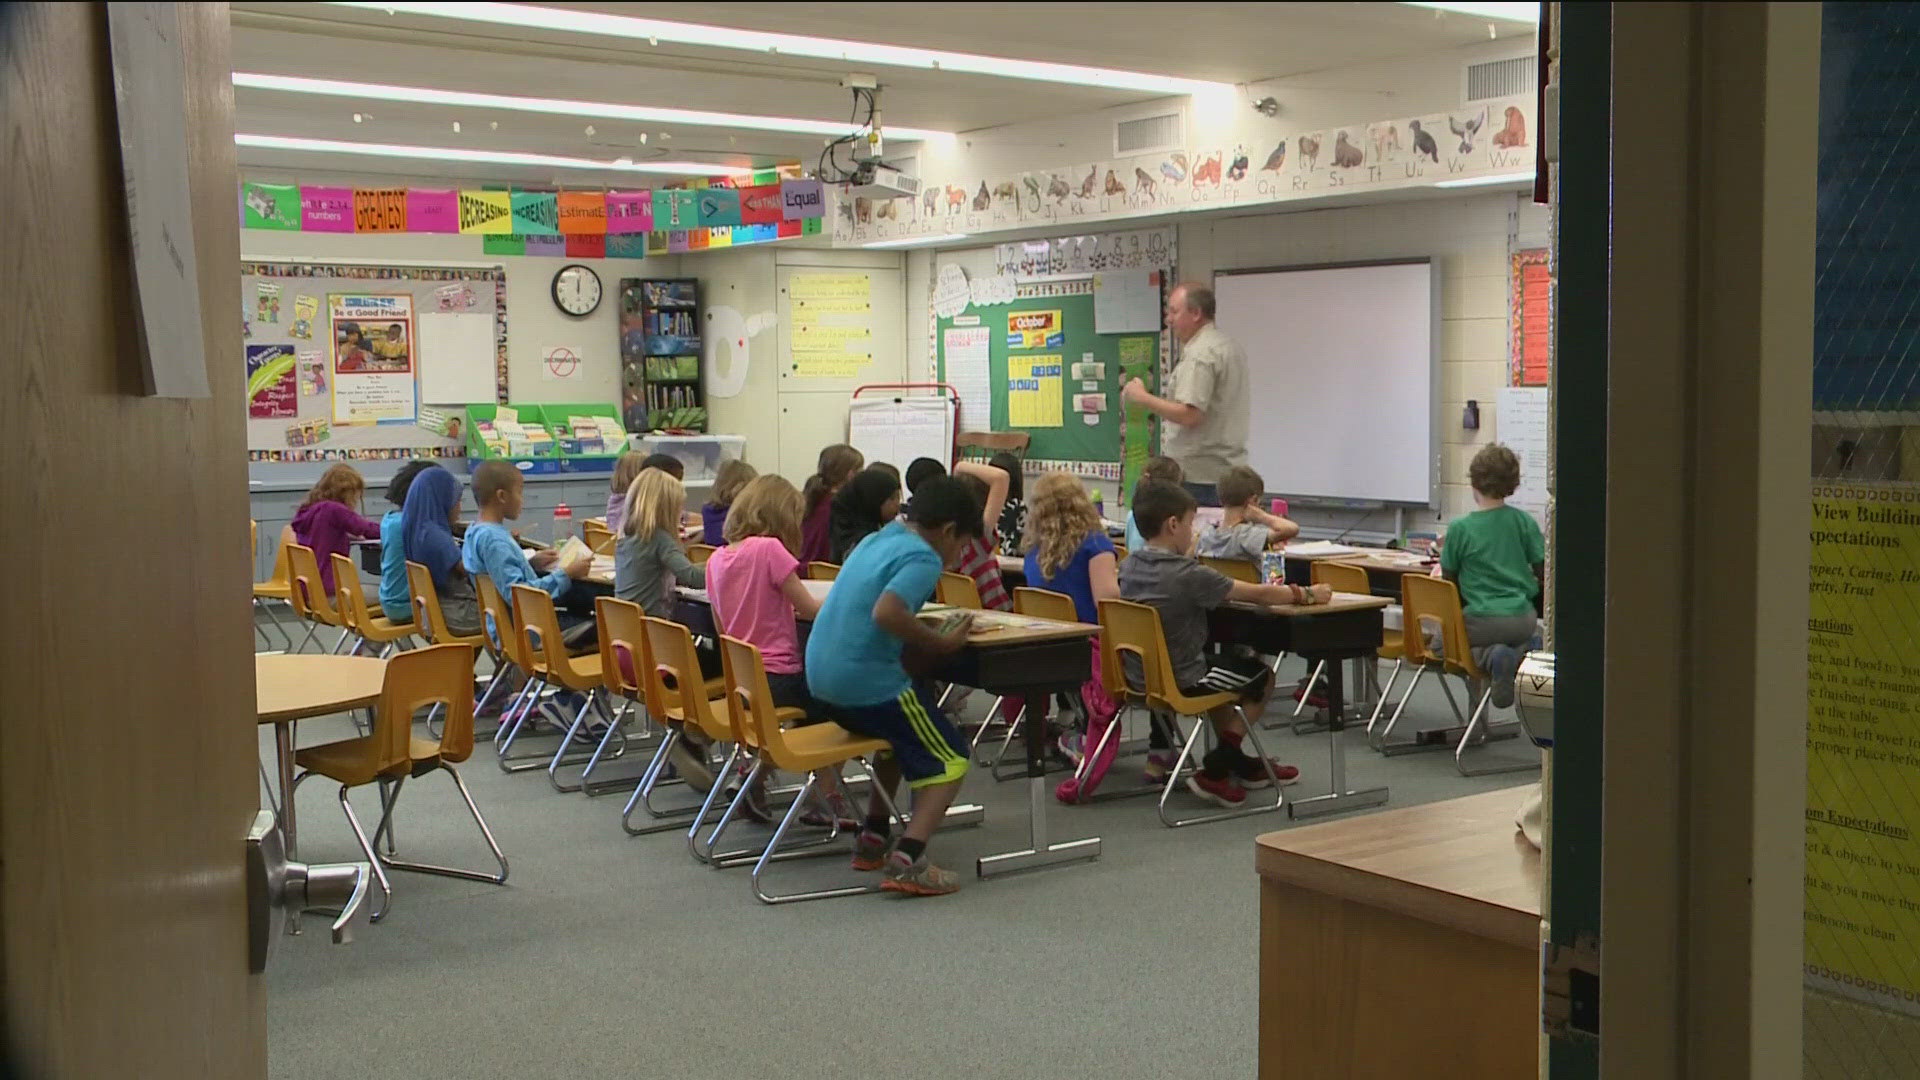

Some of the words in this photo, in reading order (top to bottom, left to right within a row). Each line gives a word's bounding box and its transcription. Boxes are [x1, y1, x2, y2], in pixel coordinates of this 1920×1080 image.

[786, 190, 820, 209] Equal
[856, 227, 867, 239] Bb
[1071, 202, 1084, 215] Kk
[1129, 196, 1148, 209] Mm
[1160, 192, 1175, 205] Nn
[1191, 188, 1208, 202] Oo
[1224, 185, 1239, 202] Pp
[1257, 180, 1277, 199] Qq
[1292, 176, 1308, 191] Rr
[1329, 171, 1344, 187] Ss
[1368, 165, 1381, 182] Tt
[1405, 163, 1423, 178] Uu
[1448, 157, 1464, 173] Vv
[1489, 151, 1520, 168] Ww
[308, 211, 341, 221] numbers
[355, 191, 405, 229] GREATEST
[460, 195, 509, 229] DECREASING
[335, 309, 344, 317] Be
[356, 309, 379, 317] Good
[1016, 316, 1046, 327] October
[1813, 503, 1850, 520] View
[1849, 565, 1894, 584] Caring,
[1843, 582, 1875, 596] Trust
[1830, 656, 1850, 667] and
[1854, 657, 1881, 670] food
[1827, 673, 1838, 683] in
[1851, 675, 1876, 688] safe
[1820, 689, 1866, 704] finished
[1869, 697, 1910, 713] eating,
[1829, 706, 1846, 719] the
[1850, 710, 1879, 724] table
[1818, 723, 1848, 738] trash,
[1853, 728, 1873, 741] left
[1876, 734, 1904, 746] over
[1814, 740, 1851, 755] proper
[1855, 747, 1886, 761] place
[1827, 809, 1909, 838] Expectations
[1822, 844, 1831, 856] &
[1881, 858, 1892, 869] to
[1821, 879, 1832, 890] as
[1837, 884, 1858, 898] you
[1861, 890, 1897, 906] move
[1863, 925, 1896, 942] clean
